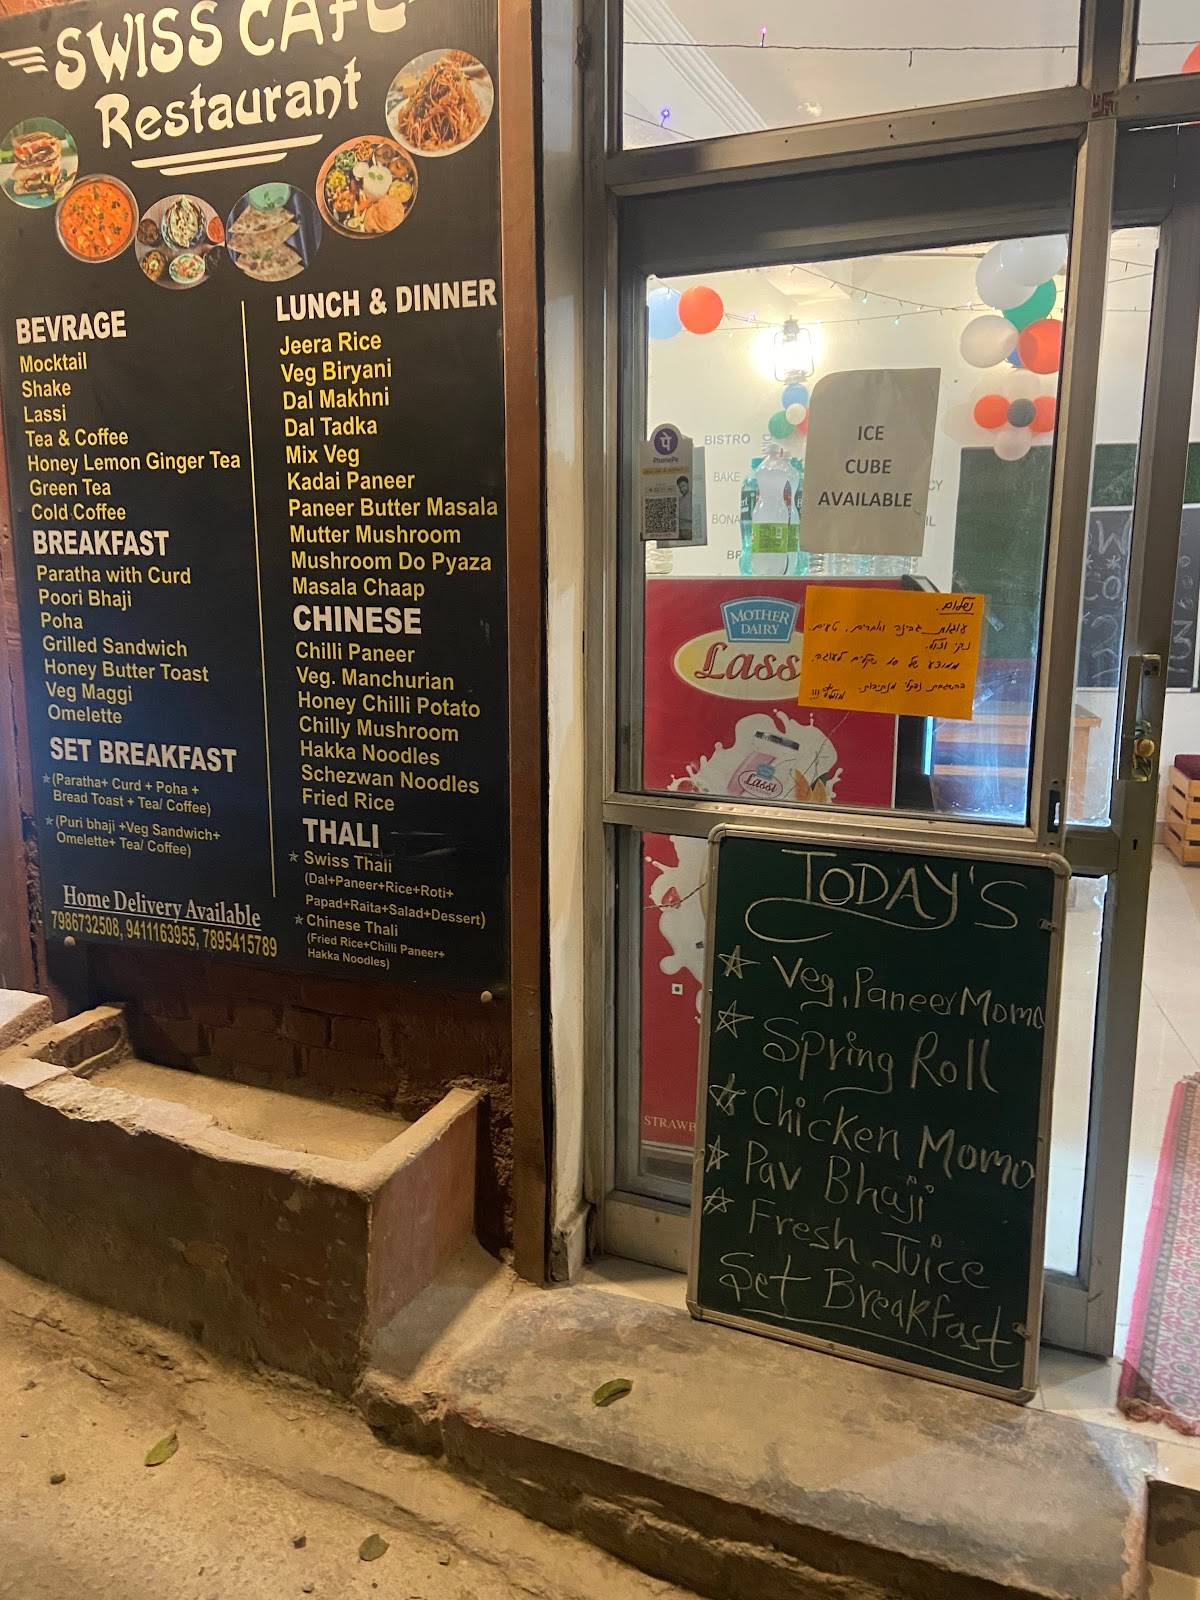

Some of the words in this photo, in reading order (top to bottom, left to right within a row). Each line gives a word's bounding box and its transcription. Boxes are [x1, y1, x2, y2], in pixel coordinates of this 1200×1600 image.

[55, 0, 223, 90] SWISS
[94, 56, 361, 149] Restaurant
[276, 290, 360, 322] LUNCH
[369, 287, 388, 315] &
[396, 278, 498, 313] DINNER
[15, 310, 127, 344] BEVRAGE
[279, 336, 332, 355] Jeera
[338, 331, 382, 351] Rice
[19, 352, 87, 373] Mocktail
[281, 363, 316, 387] Veg
[322, 358, 393, 384] Biryani
[21, 379, 72, 398] Shake
[283, 390, 313, 410] Dal
[319, 386, 390, 408] Makhni
[24, 404, 67, 423] Lassi
[25, 430, 53, 447] Tea
[58, 429, 70, 446] &
[74, 428, 129, 446] Coffee
[284, 417, 315, 437] Dal
[320, 416, 378, 435] Tadka
[858, 426, 884, 440] ICE
[704, 434, 750, 445] BISTRO
[27, 455, 79, 476] Honey
[83, 453, 141, 471] Lemon
[145, 452, 205, 475] Ginger
[209, 450, 241, 469] Tea
[286, 445, 318, 464] Mix
[323, 444, 360, 468] Veg
[845, 459, 892, 474] CUBE
[29, 479, 78, 496] Green
[81, 478, 111, 495] Tea
[287, 471, 340, 491] Kadai
[346, 471, 415, 490] Paneer
[288, 498, 354, 517] Paneer
[360, 497, 421, 517] Butter
[426, 497, 498, 516] Masala
[818, 491, 912, 507] AVAILABLE
[31, 503, 68, 521] Cold
[73, 503, 127, 521] Coffee
[32, 529, 170, 556] BREAKFAST
[290, 524, 350, 543] Mutter
[355, 524, 461, 544] Mushroom
[36, 564, 101, 583] Paratha
[106, 566, 143, 583] with
[147, 566, 192, 585] Curd
[291, 551, 392, 570] Mushroom
[399, 551, 426, 570] Do
[431, 552, 492, 576] Pyaza
[38, 588, 83, 606] Poori
[88, 589, 132, 611] Bhaji
[292, 576, 357, 595] Masala
[363, 577, 425, 601] Chaap
[40, 611, 84, 630] Poha
[293, 605, 422, 635] CHINESE
[730, 608, 791, 626] MOTHER
[741, 623, 780, 635] DAIRY
[42, 635, 97, 653] Grilled
[102, 636, 188, 657] Sandwich
[295, 641, 342, 660] Chilli
[348, 643, 415, 663] Paneer
[44, 658, 97, 681] Honey
[102, 660, 156, 679] Butter
[159, 663, 209, 682] Toast
[694, 641, 801, 681] Lass
[296, 666, 336, 688] Veg.
[342, 667, 454, 691] Manchurian
[45, 681, 76, 702] Veg
[81, 683, 133, 705] Maggi
[298, 691, 356, 715] Honey
[362, 693, 410, 713] Chilli
[417, 697, 481, 718] Potato
[47, 703, 123, 724] Omelette
[299, 715, 351, 739] Chilly
[357, 719, 459, 742] Mushroom
[50, 736, 92, 762] SET
[99, 740, 237, 773] BREAKFAST
[300, 739, 356, 761] Hakka
[362, 744, 441, 766] Noodles
[112, 776, 142, 791] Curd
[156, 781, 188, 795] Poha
[301, 764, 394, 787] Schezwan
[400, 771, 480, 794] Noodles
[53, 790, 88, 803] Bread
[91, 793, 124, 807] Toast
[166, 799, 212, 818] Coffee)
[302, 788, 348, 808] Fried
[354, 792, 395, 811] Rice
[55, 815, 83, 829] (Puri
[86, 818, 116, 832] bhaji
[152, 824, 221, 841] Sandwich+
[302, 818, 379, 849] THALI
[147, 840, 192, 859] Coffee)
[304, 851, 349, 869] Swiss
[354, 855, 392, 873] Thali
[63, 885, 110, 910] Home
[113, 890, 182, 923] Delivery
[185, 899, 261, 927] Available
[307, 914, 361, 932] Chinese
[364, 920, 398, 937] Thali
[203, 929, 277, 957] 7895415789
[307, 933, 337, 946] (Fried
[340, 936, 397, 953] Rice+Chilli
[400, 944, 445, 959] Paneer+
[308, 948, 340, 961] Hakka
[343, 952, 390, 970] Noodles)
[763, 1017, 894, 1104] Spring
[910, 1031, 999, 1093] Roll
[753, 1086, 900, 1161] Chicken
[918, 1125, 1035, 1190] Momo
[745, 1140, 801, 1191] Pav
[824, 1155, 935, 1223] Bhaji
[749, 1199, 860, 1264] Fresh
[872, 1231, 990, 1289] Juice
[719, 1252, 811, 1303] Set
[823, 1268, 1019, 1368] Breakfast
